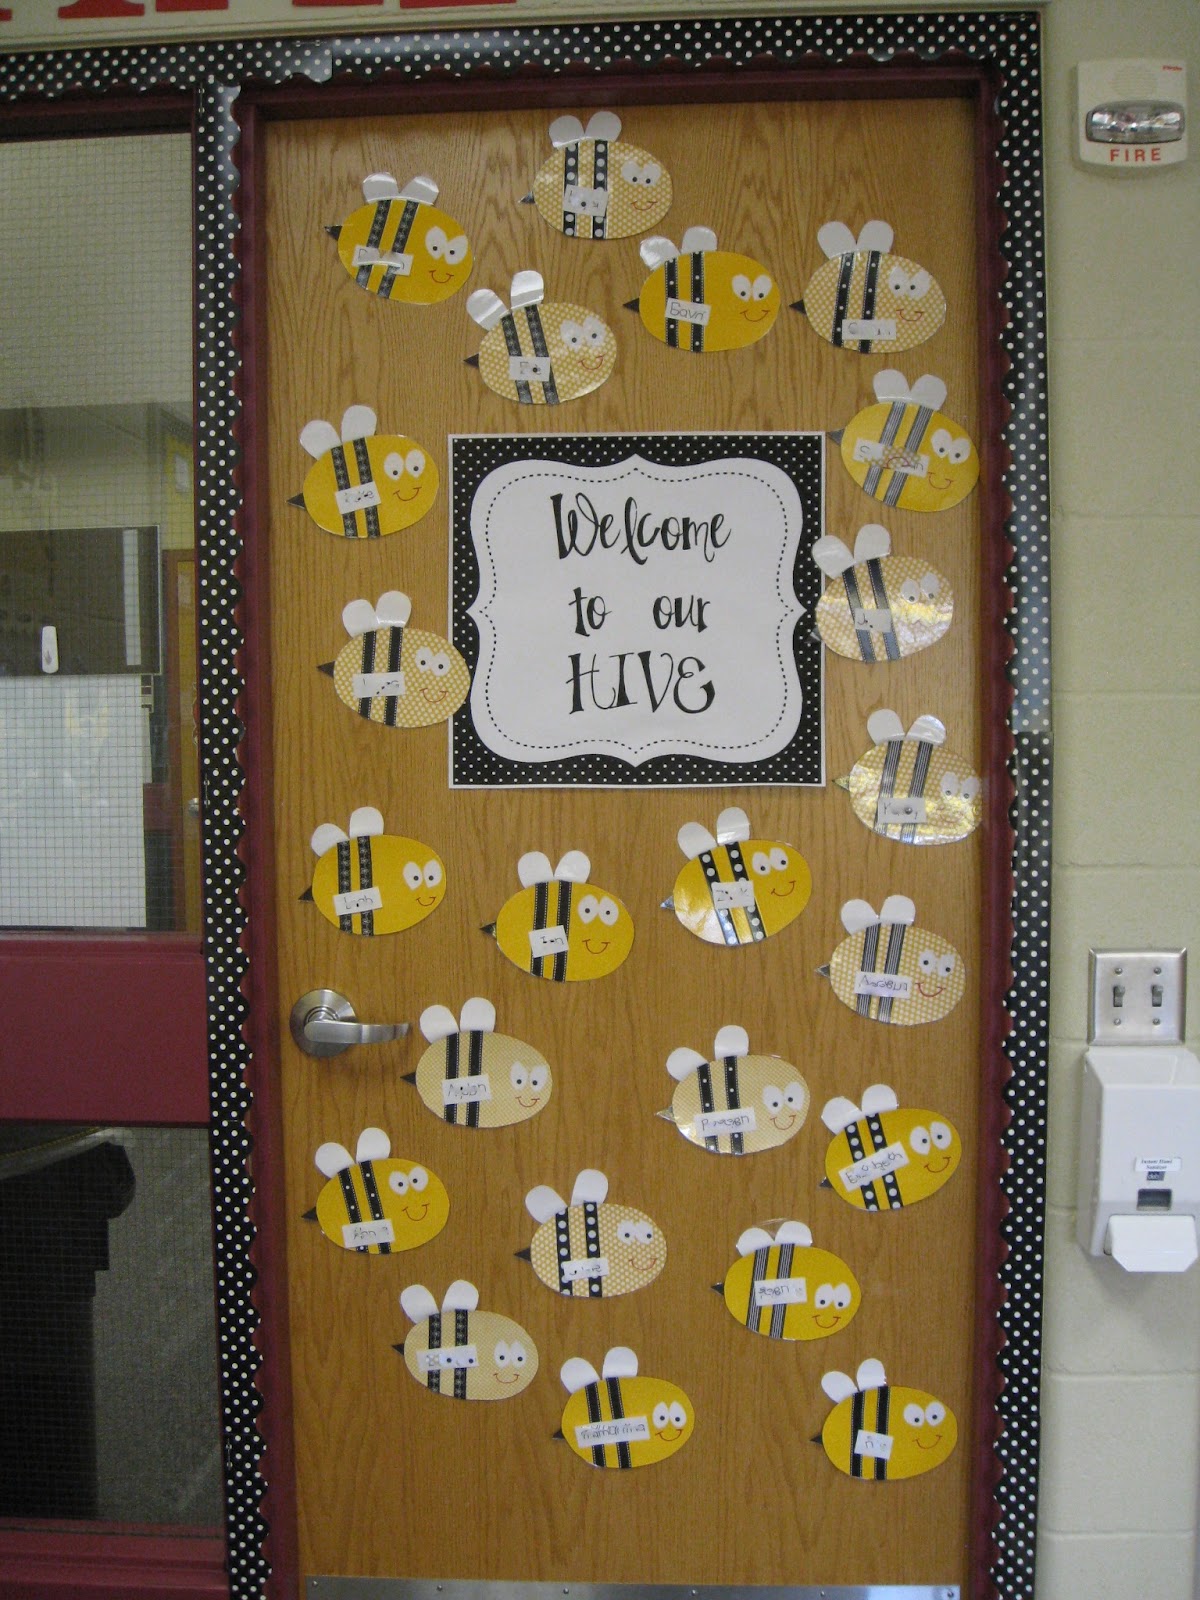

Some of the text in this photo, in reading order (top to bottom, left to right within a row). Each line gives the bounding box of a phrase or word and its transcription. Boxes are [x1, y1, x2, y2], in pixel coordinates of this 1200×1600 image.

[1110, 148, 1162, 162] FIRE
[550, 492, 732, 566] Welcome
[568, 587, 711, 637] to our
[565, 650, 716, 715] HIVE
